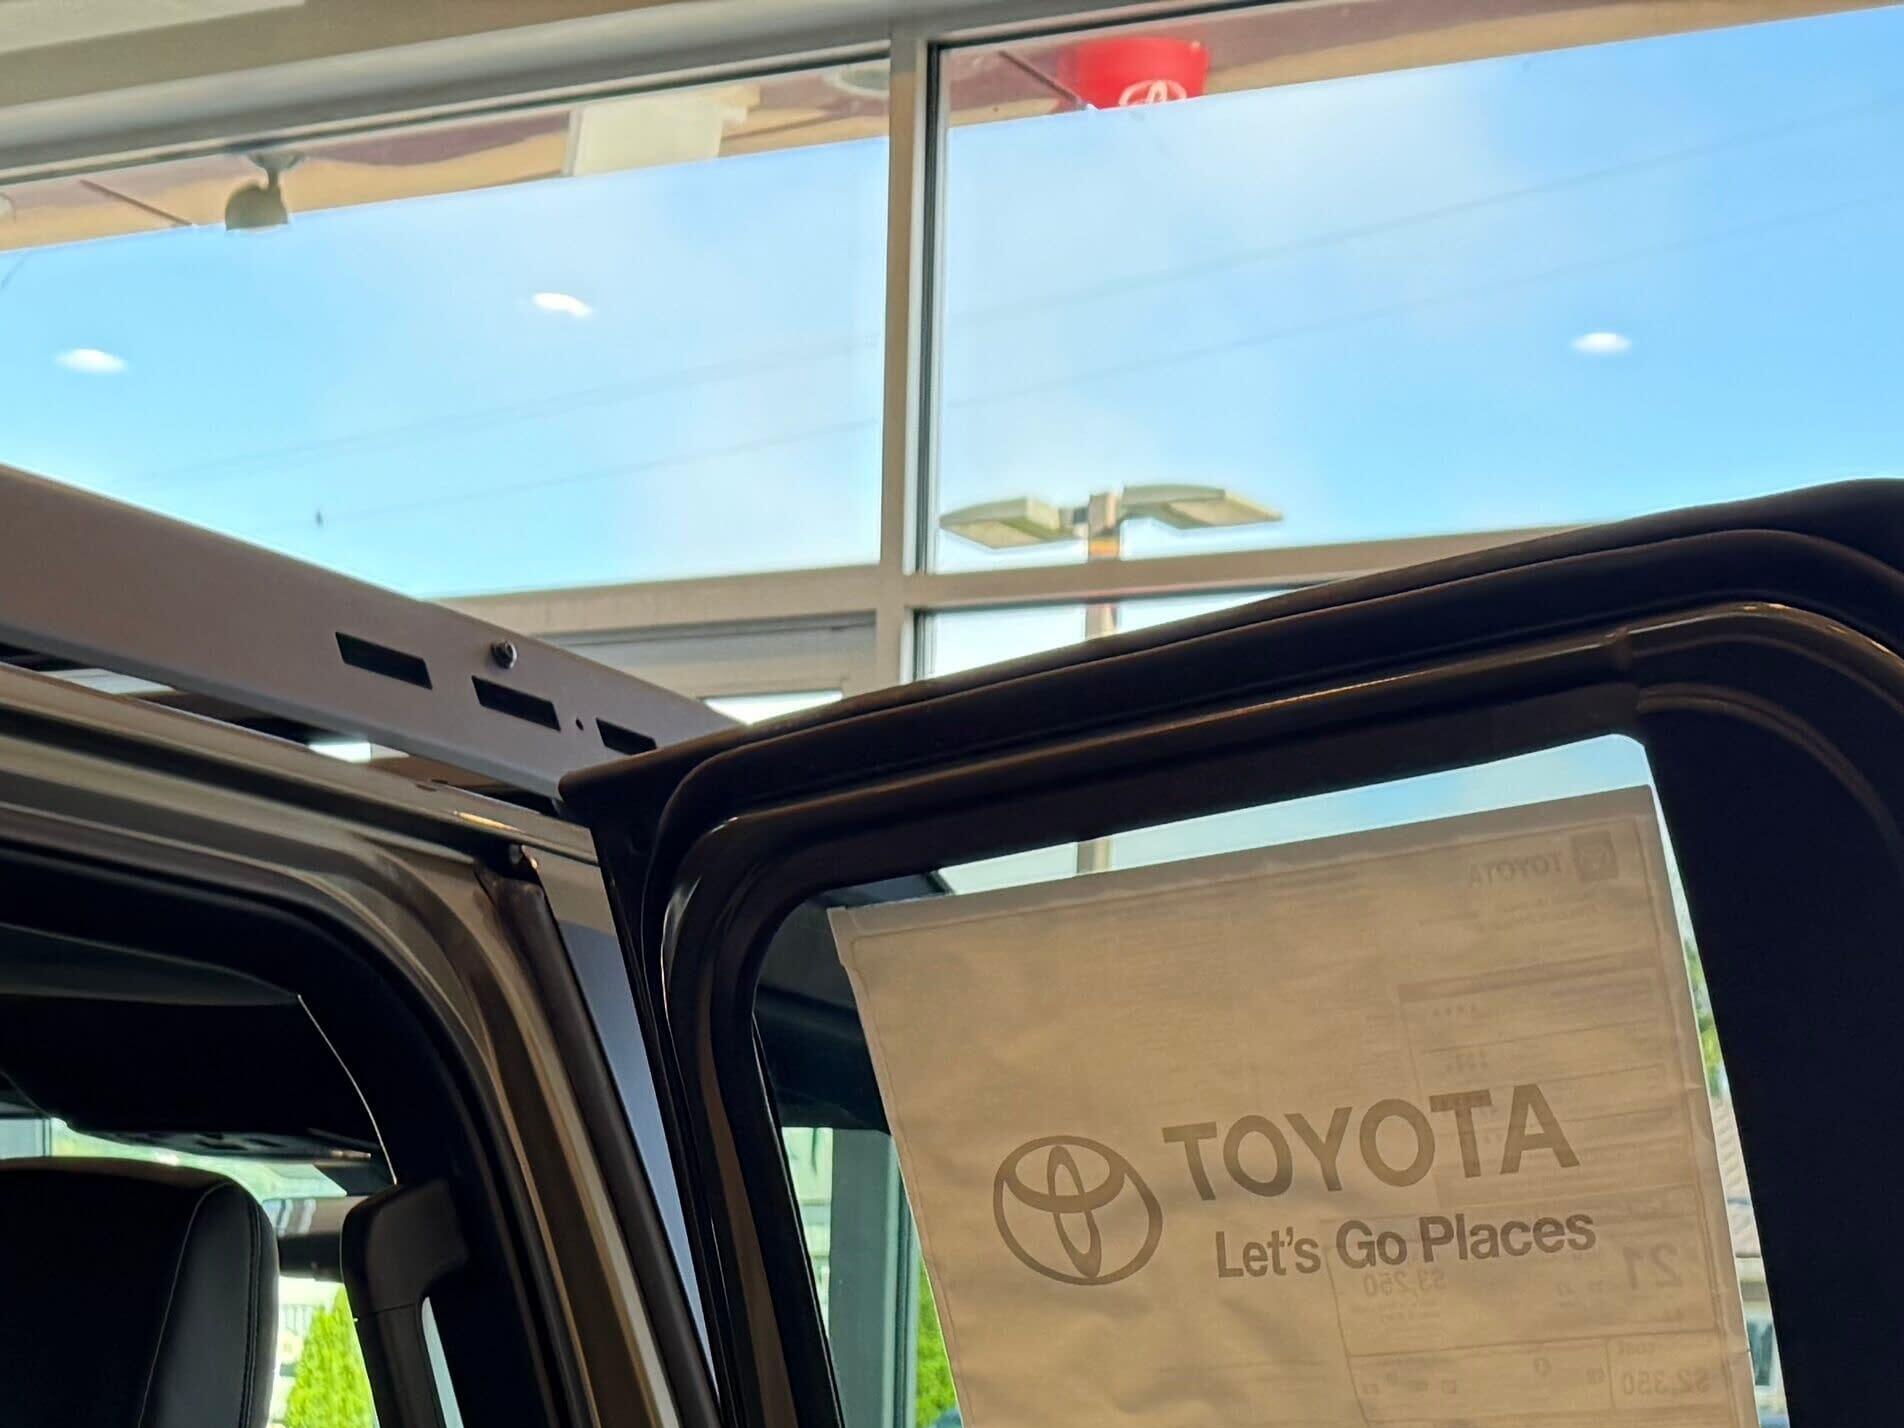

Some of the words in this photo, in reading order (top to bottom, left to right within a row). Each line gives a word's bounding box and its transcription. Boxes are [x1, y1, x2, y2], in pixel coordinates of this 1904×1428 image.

[1163, 1084, 1581, 1201] TOYOTA
[1216, 1226, 1321, 1279] Let's
[1335, 1217, 1409, 1271] Go
[1419, 1208, 1596, 1260] Places
